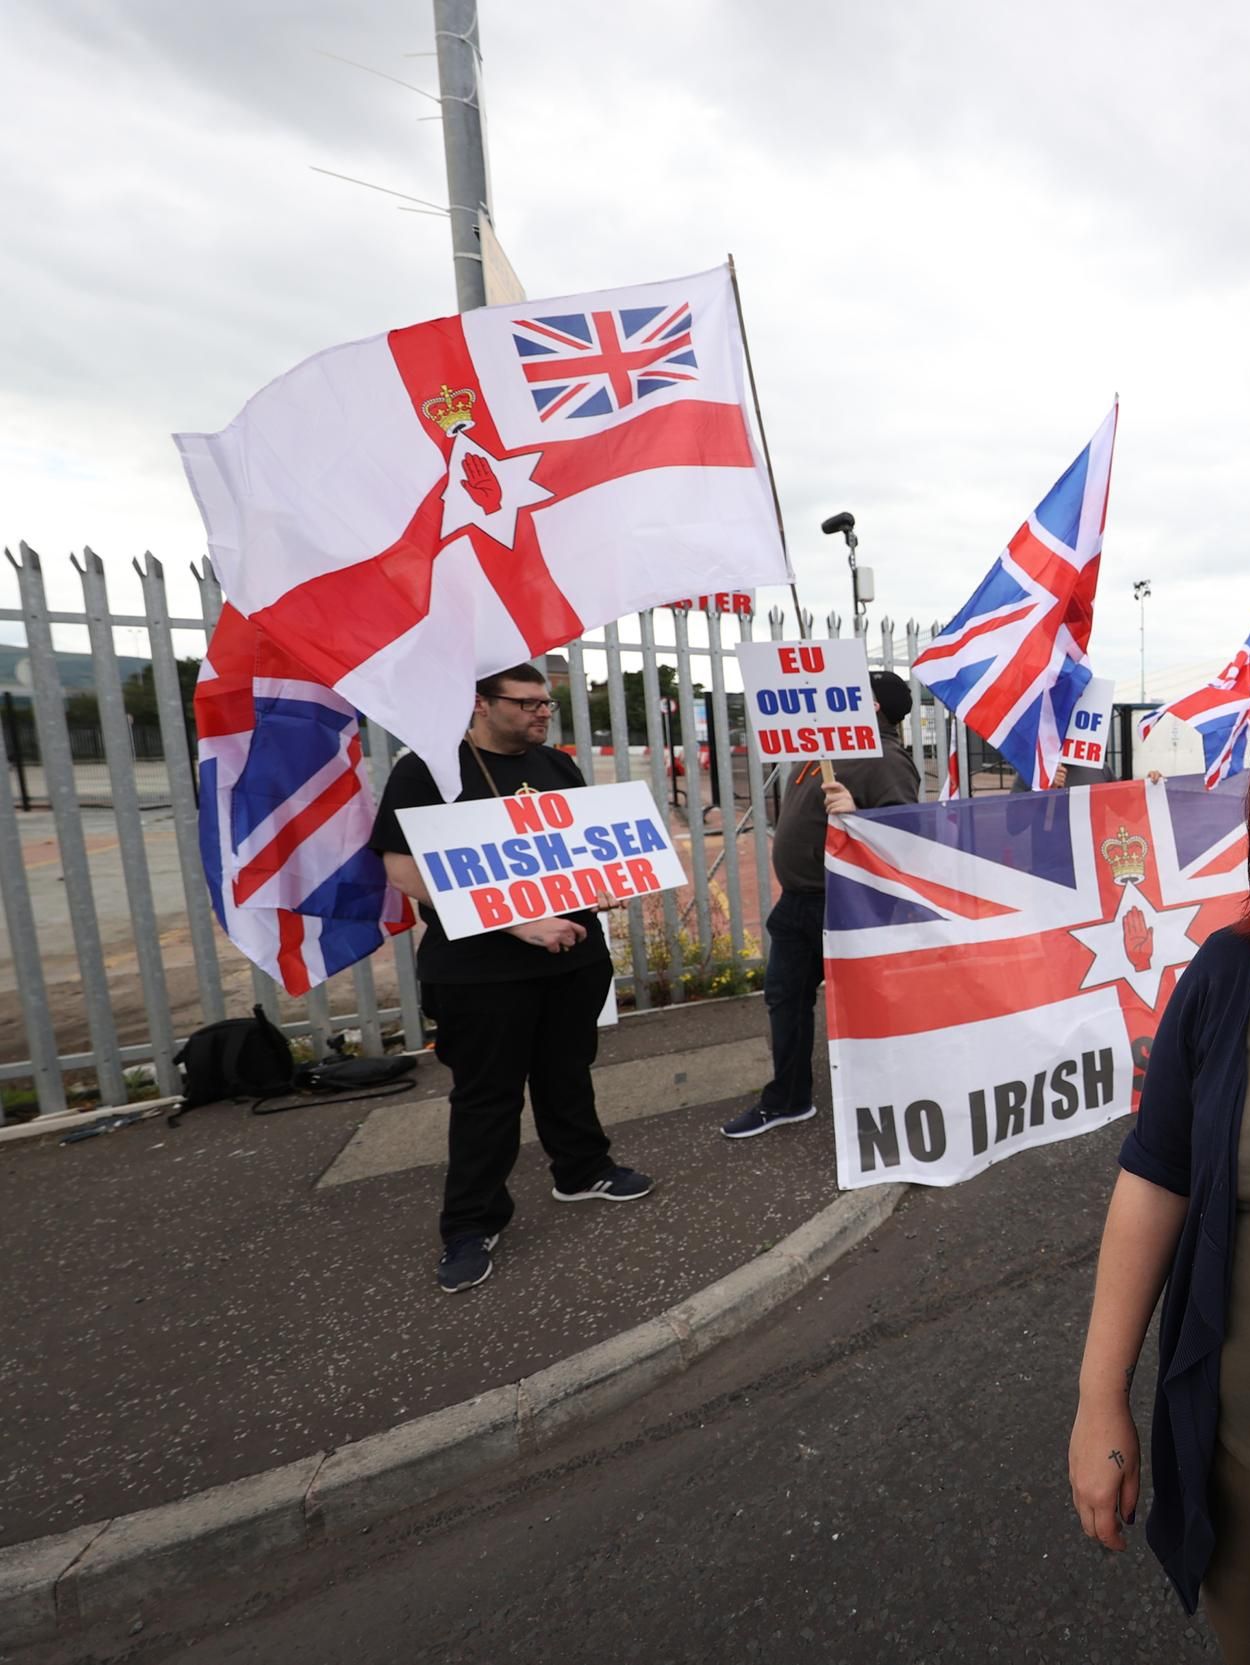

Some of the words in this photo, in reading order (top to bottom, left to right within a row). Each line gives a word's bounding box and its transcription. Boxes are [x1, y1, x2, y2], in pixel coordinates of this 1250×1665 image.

[777, 646, 825, 674] EU
[756, 688, 817, 716] OUT
[825, 686, 862, 713] OF
[1074, 710, 1103, 732] OF
[758, 725, 877, 755] ULSTER
[502, 793, 575, 835] NO
[422, 818, 668, 893] IRISH-SEA
[469, 858, 661, 929] BORDER
[855, 1099, 947, 1173] NO
[968, 1047, 1115, 1156] IRISH
